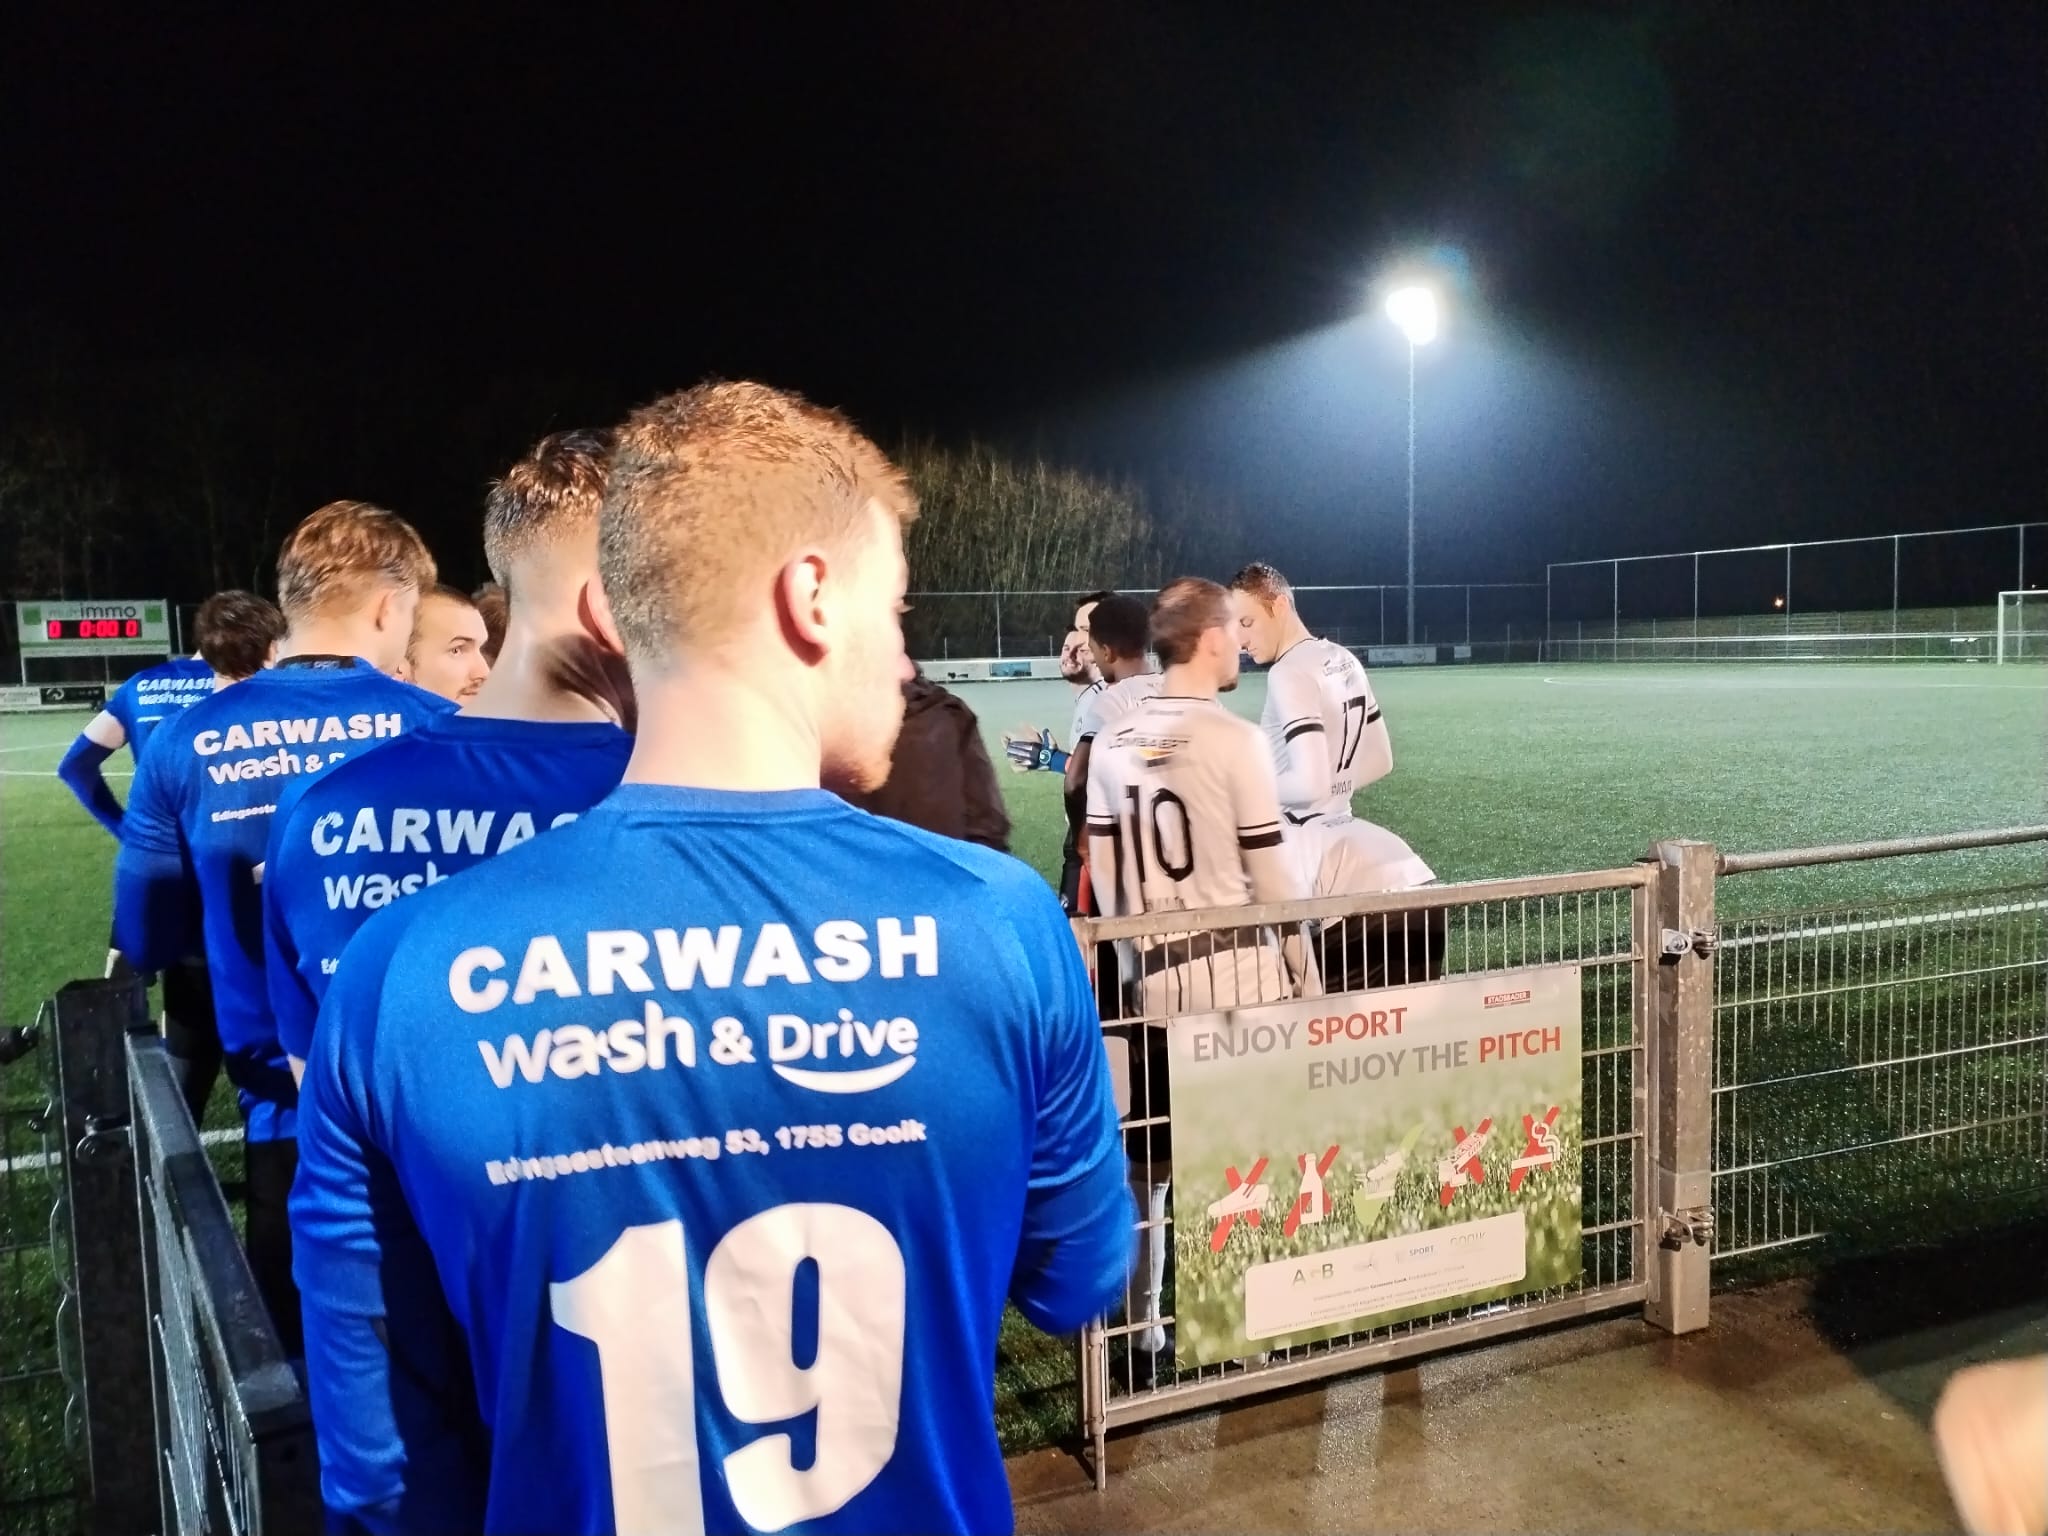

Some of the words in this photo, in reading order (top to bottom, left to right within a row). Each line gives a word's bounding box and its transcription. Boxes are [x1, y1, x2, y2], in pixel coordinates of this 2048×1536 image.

[49, 620, 61, 638] 0
[80, 620, 119, 638] 0:00
[126, 620, 138, 637] 0
[80, 603, 137, 618] immo
[137, 678, 214, 692] CARWASH
[193, 713, 401, 756] CARWASH
[1335, 695, 1366, 773] 17
[207, 748, 300, 785] wash
[305, 754, 324, 773] &
[311, 807, 579, 855] CARWA
[1125, 784, 1195, 883] 10
[448, 915, 939, 1014] CARWASH
[478, 1000, 696, 1089] wash
[709, 1016, 757, 1065] &
[768, 1008, 919, 1062] Drive
[1193, 1021, 1298, 1062] ENJOY
[1307, 1007, 1408, 1046] SPORT
[1308, 1050, 1406, 1090] ENJOY
[1412, 1040, 1469, 1073] THE
[1479, 1026, 1562, 1063] PITCH
[774, 1124, 844, 1150] 1755
[549, 1202, 906, 1536] 19
